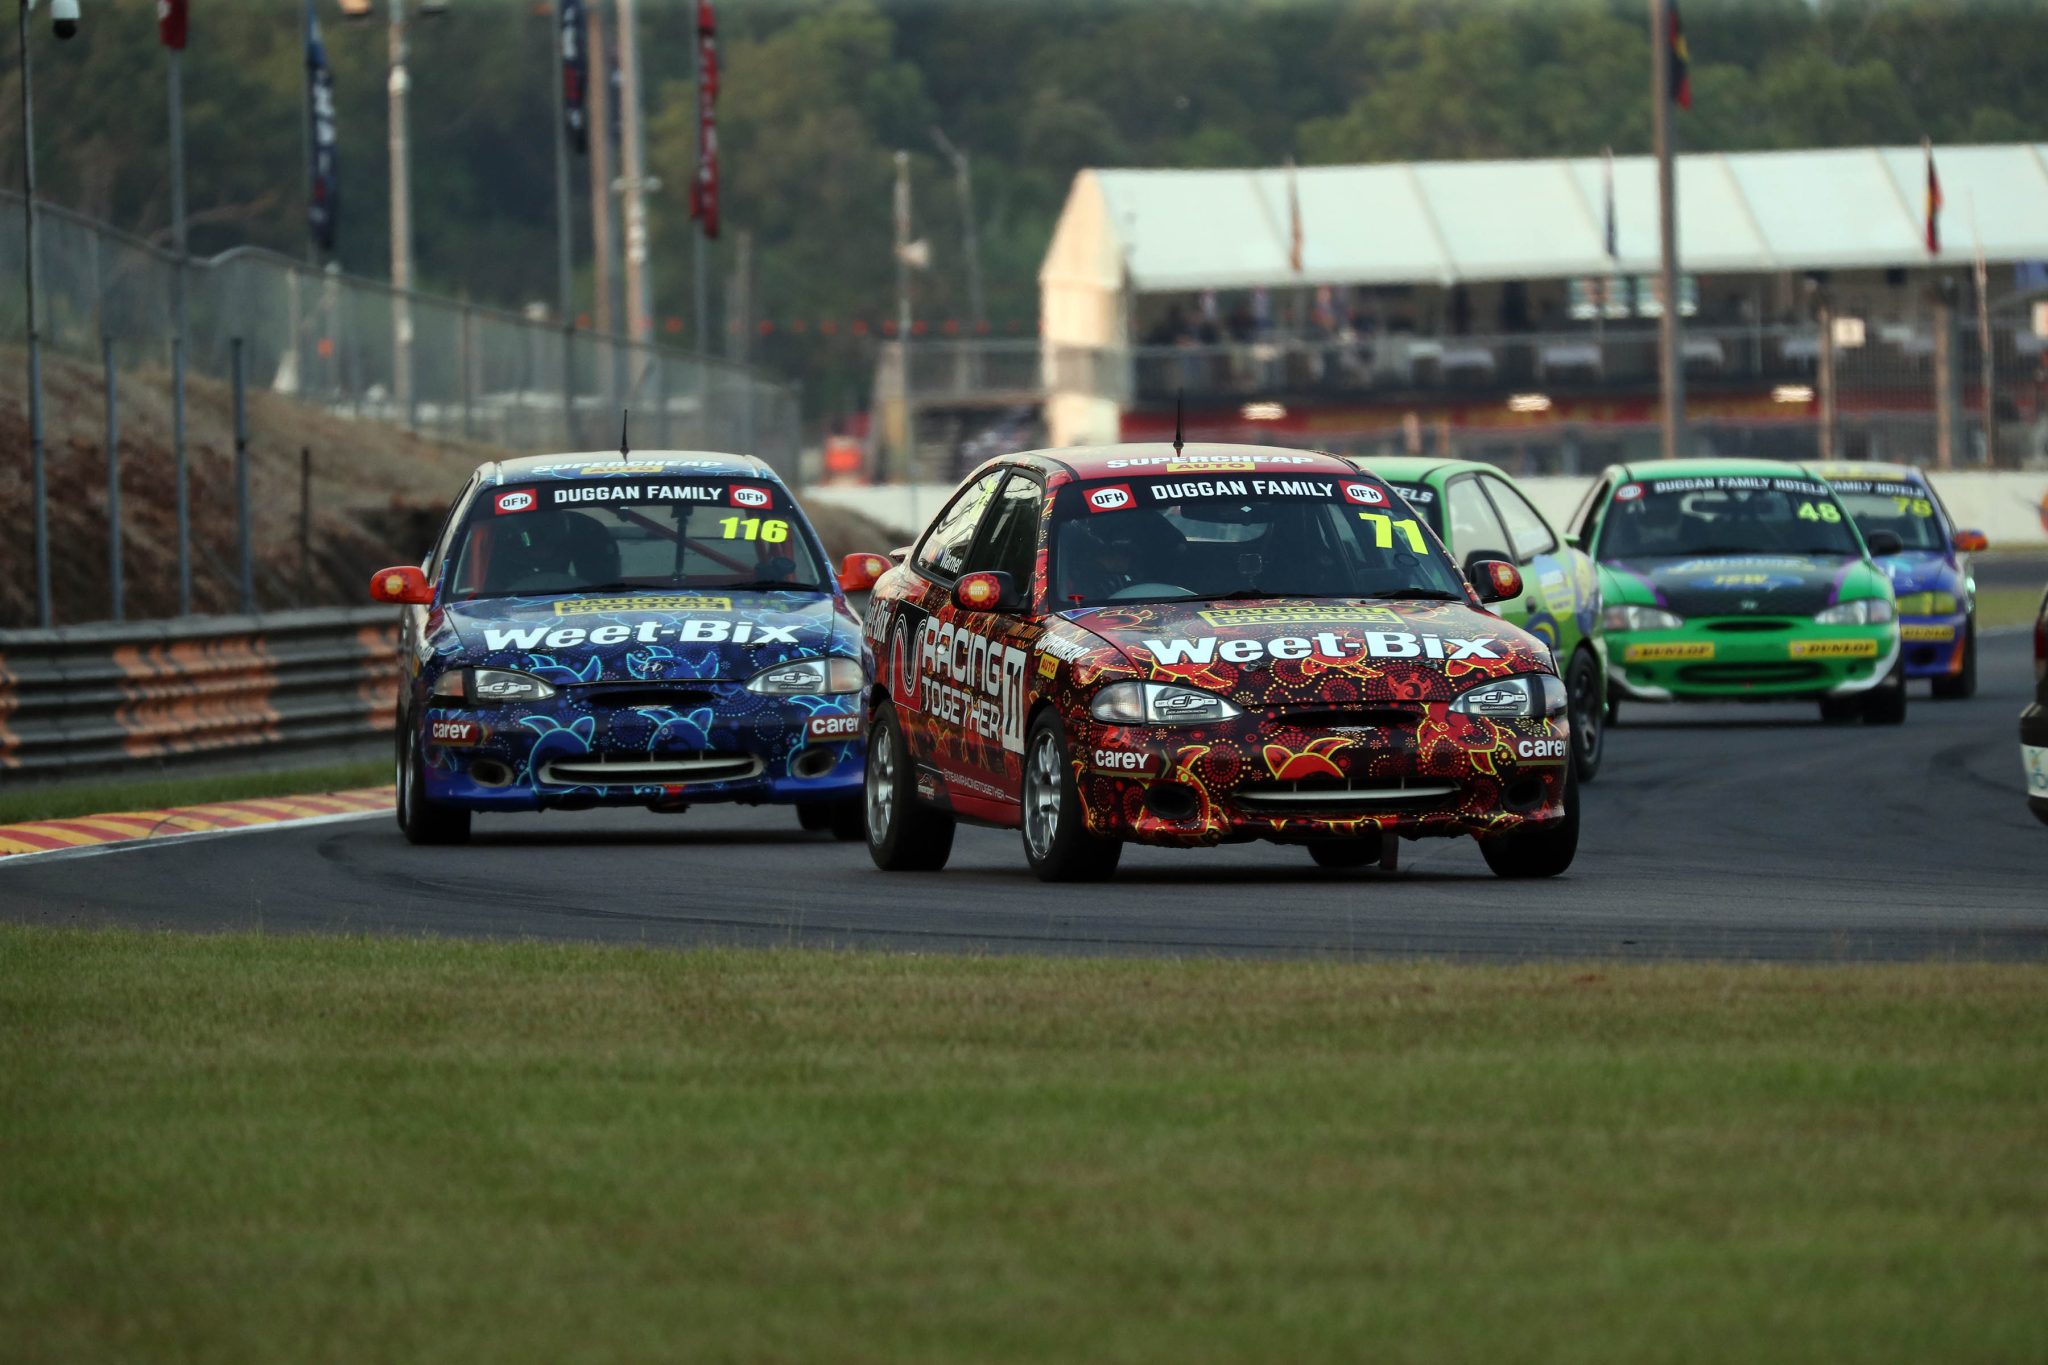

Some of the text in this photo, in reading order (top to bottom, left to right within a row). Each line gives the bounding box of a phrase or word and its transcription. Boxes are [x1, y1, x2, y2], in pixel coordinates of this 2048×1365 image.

[532, 460, 725, 472] SUPERCHEAP
[1106, 455, 1314, 468] SUPERCHEAP
[1175, 463, 1247, 471] AUTO
[554, 486, 722, 503] DUGGAN FAMILY
[1151, 481, 1334, 500] DUGGAN FAMILY
[1349, 488, 1380, 501] DFH
[1393, 485, 1434, 503] TELS
[1654, 477, 1828, 496] DUGGAN FAMILY HOTELS
[502, 496, 528, 508] DFH
[738, 491, 764, 503] DFH
[1094, 491, 1125, 505] DFH
[1798, 501, 1842, 523] 48
[719, 517, 789, 543] 116
[1358, 512, 1429, 554] 71
[560, 597, 725, 607] NATIONAL
[568, 603, 719, 612] STORAGE
[1208, 606, 1392, 617] NATIONAL
[1221, 614, 1390, 624] STORAGE
[484, 619, 803, 650] Weet-Bix
[922, 615, 1004, 696] RACING
[1142, 631, 1502, 666] Weet-Bix
[1041, 657, 1056, 675] AUTO
[921, 675, 1001, 741] TOGETHER
[433, 722, 470, 739] carey
[811, 716, 860, 735] carey
[1518, 739, 1567, 758] carey
[1095, 749, 1150, 769] carey
